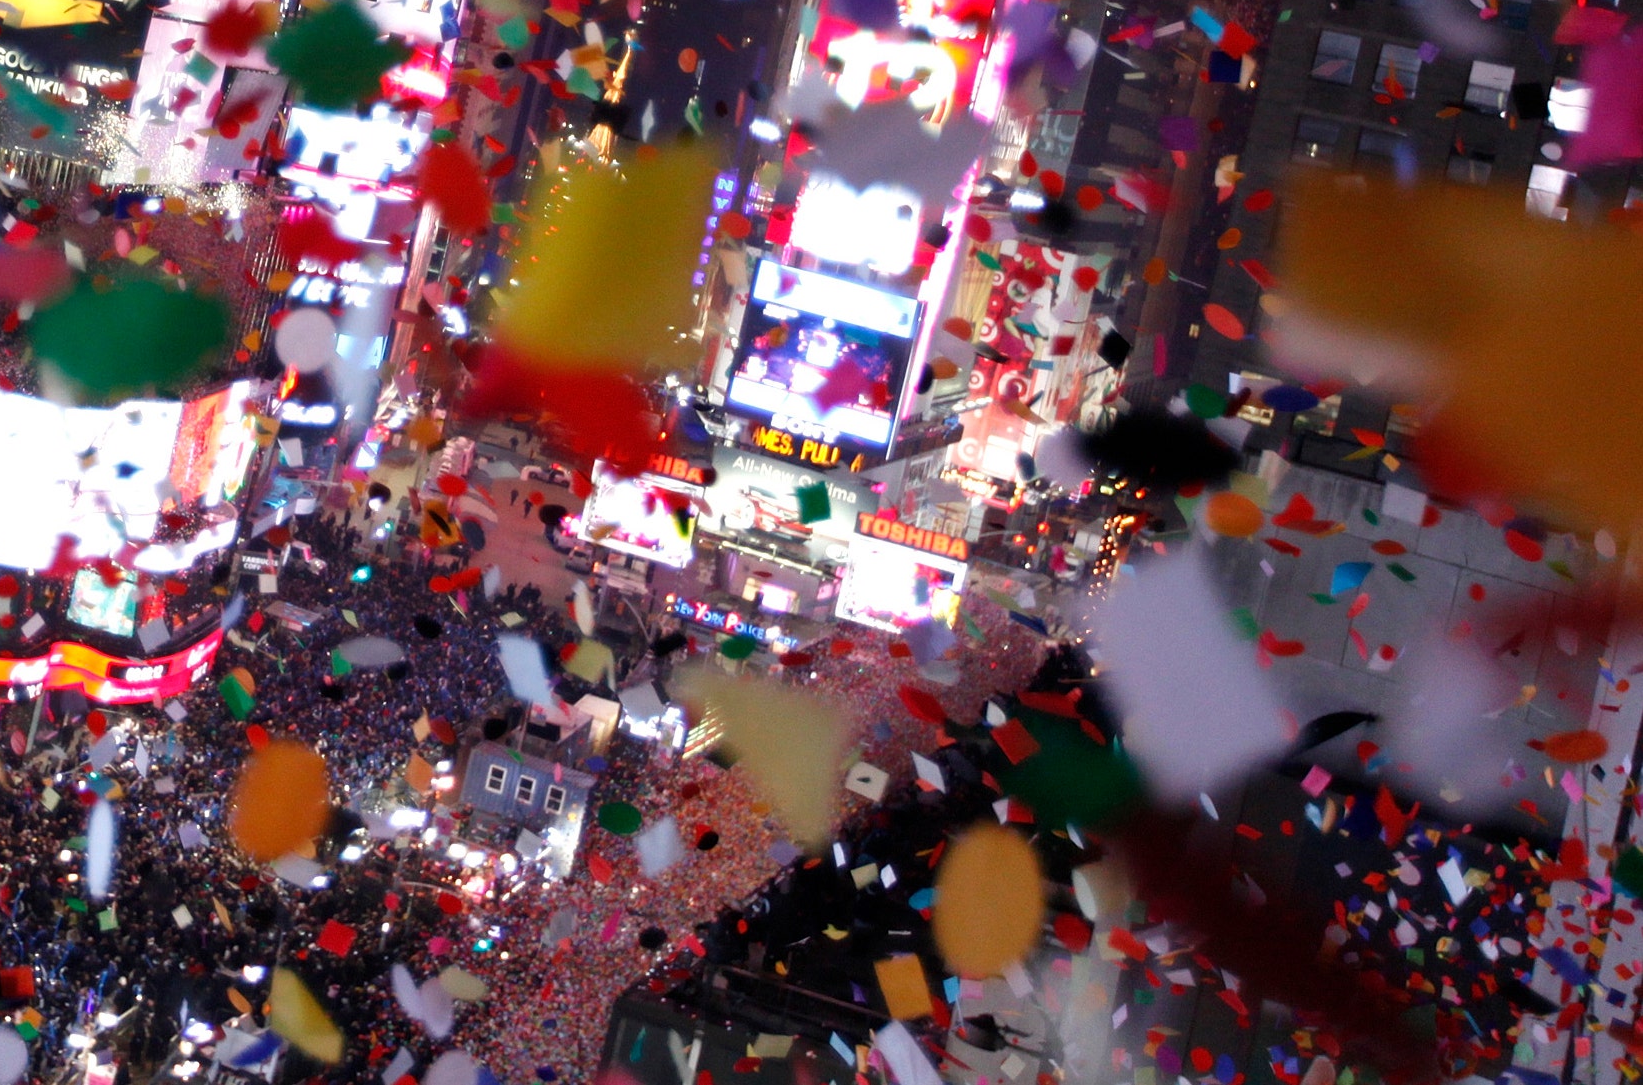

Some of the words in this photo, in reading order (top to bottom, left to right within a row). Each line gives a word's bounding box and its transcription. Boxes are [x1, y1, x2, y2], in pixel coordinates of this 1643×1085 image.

[733, 455, 796, 486] All-New
[798, 474, 857, 504] Oima
[859, 512, 969, 562] TOSHIBA
